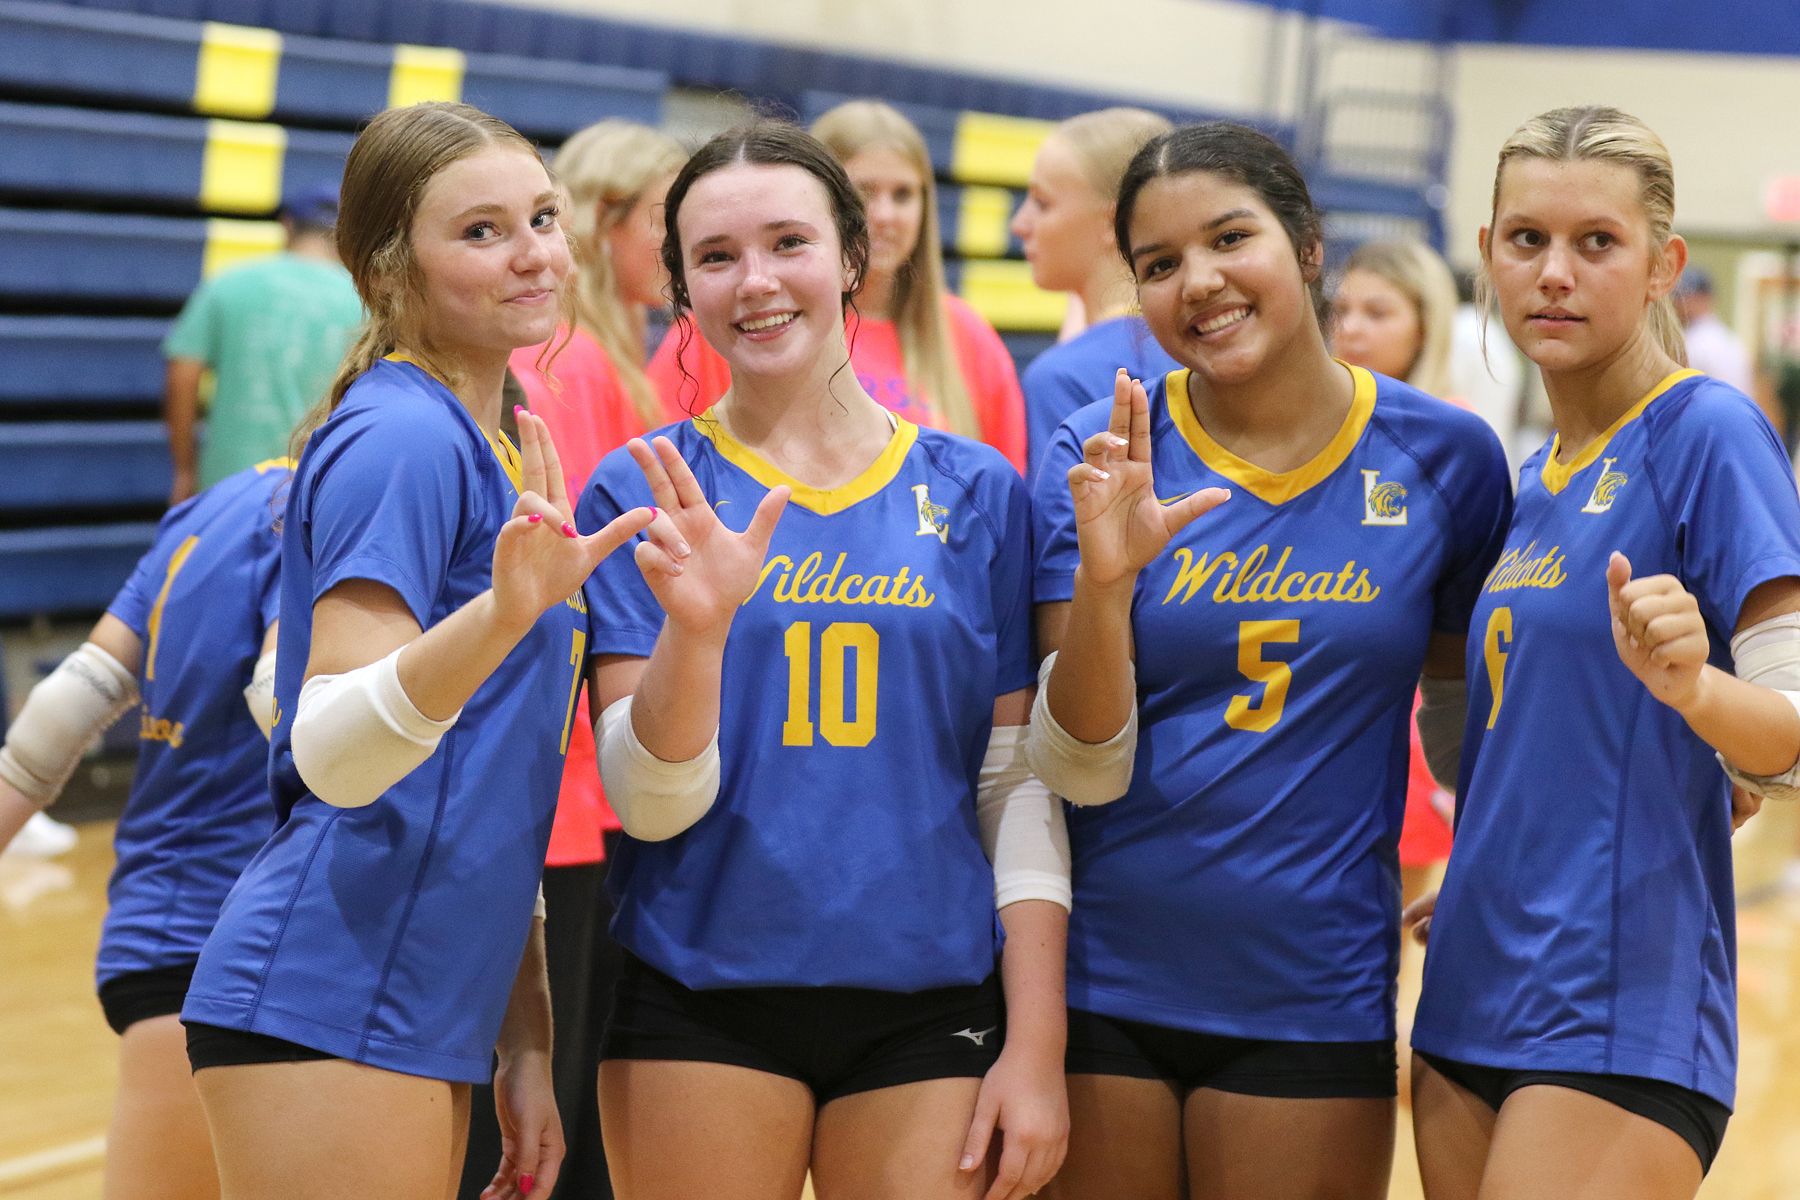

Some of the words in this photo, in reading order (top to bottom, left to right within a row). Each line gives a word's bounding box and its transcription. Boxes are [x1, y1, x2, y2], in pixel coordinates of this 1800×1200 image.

[911, 484, 950, 544] L
[1361, 469, 1408, 525] L
[1161, 544, 1381, 605] Wildcats
[782, 621, 880, 747] 10
[1224, 619, 1300, 733] 5
